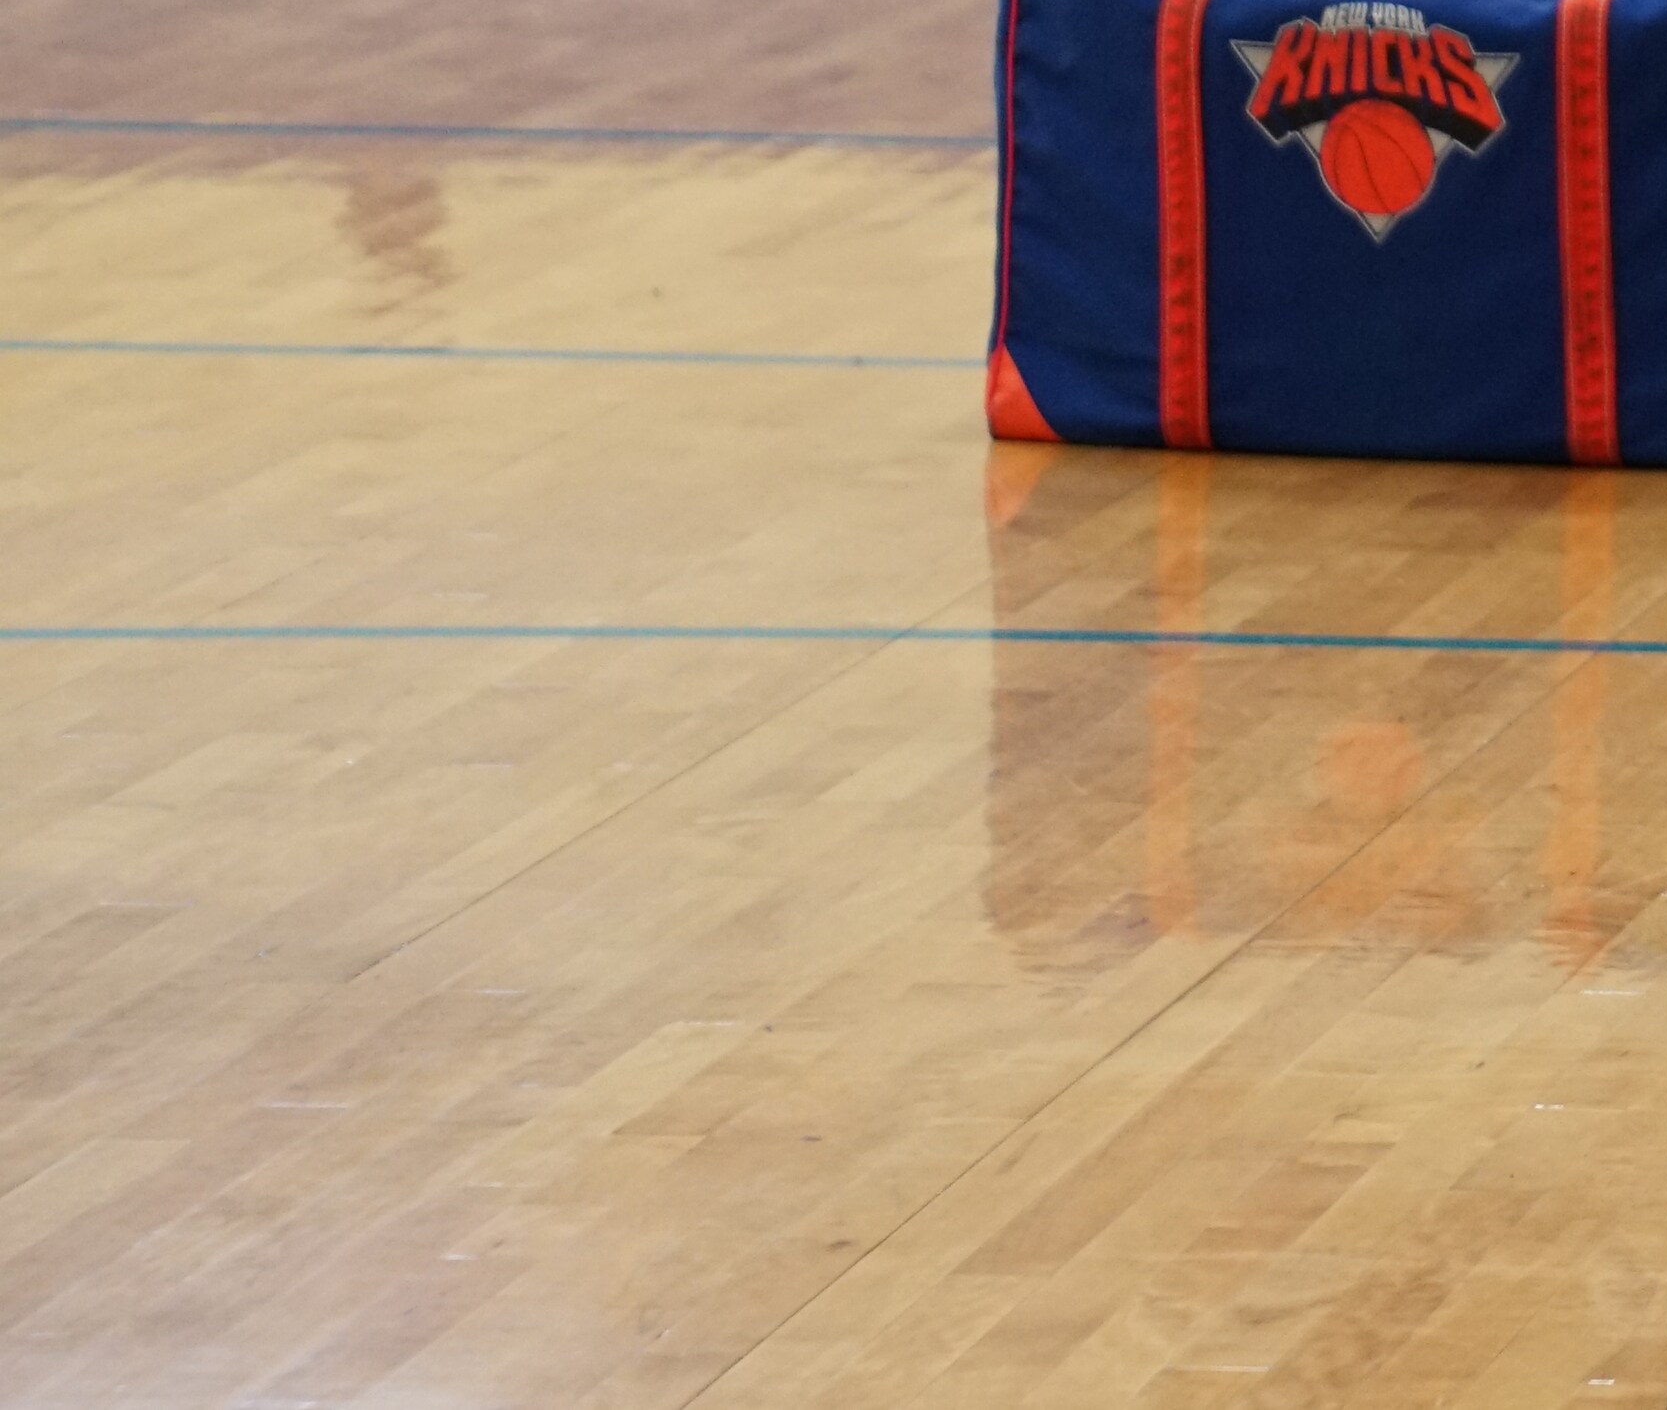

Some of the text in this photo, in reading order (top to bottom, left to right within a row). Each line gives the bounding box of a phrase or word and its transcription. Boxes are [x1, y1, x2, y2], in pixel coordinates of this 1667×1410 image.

[1321, 1, 1427, 38] NEW YORK
[1248, 17, 1503, 136] KNICKS
